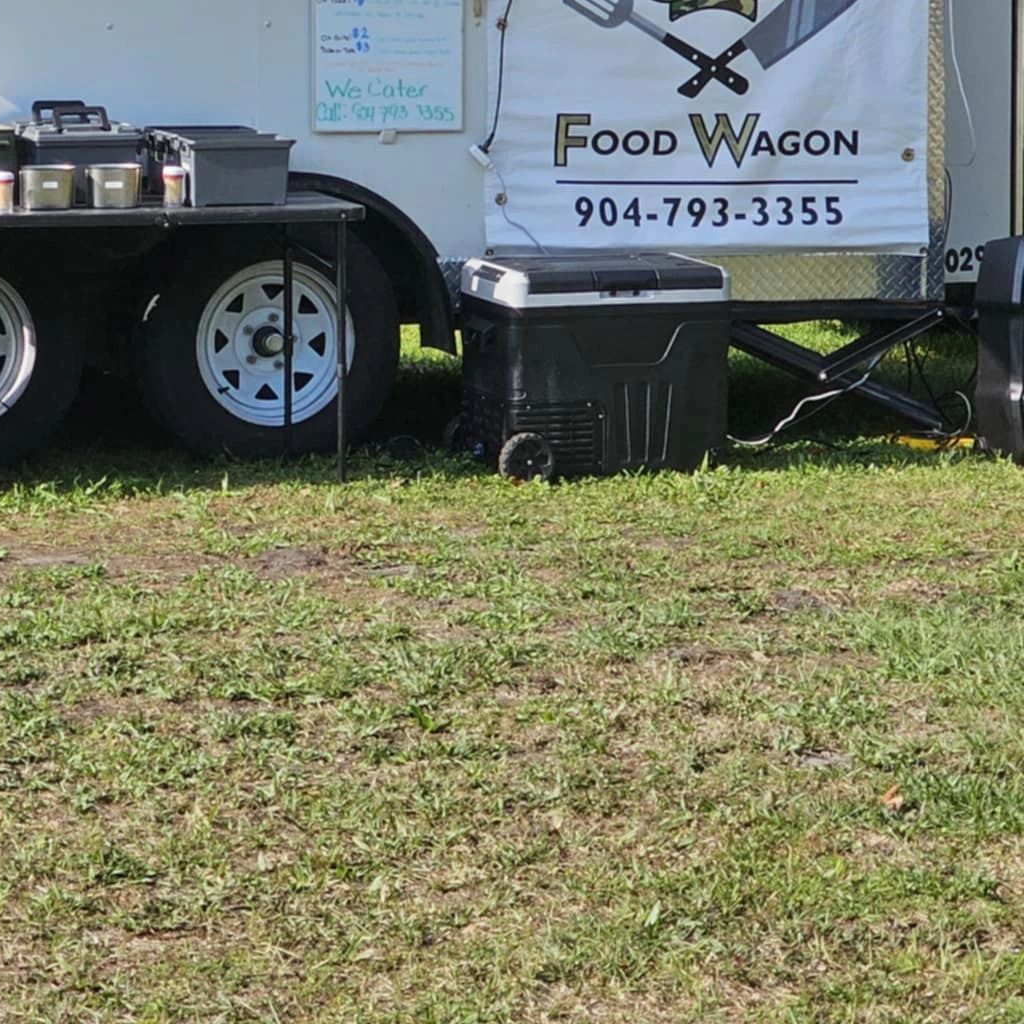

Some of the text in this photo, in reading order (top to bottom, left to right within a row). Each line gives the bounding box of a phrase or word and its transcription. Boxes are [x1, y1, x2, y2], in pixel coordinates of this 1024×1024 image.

[325, 78, 429, 99] We Cater
[554, 113, 858, 169] FOOD WAGON
[575, 196, 844, 227] 904-793-3355
